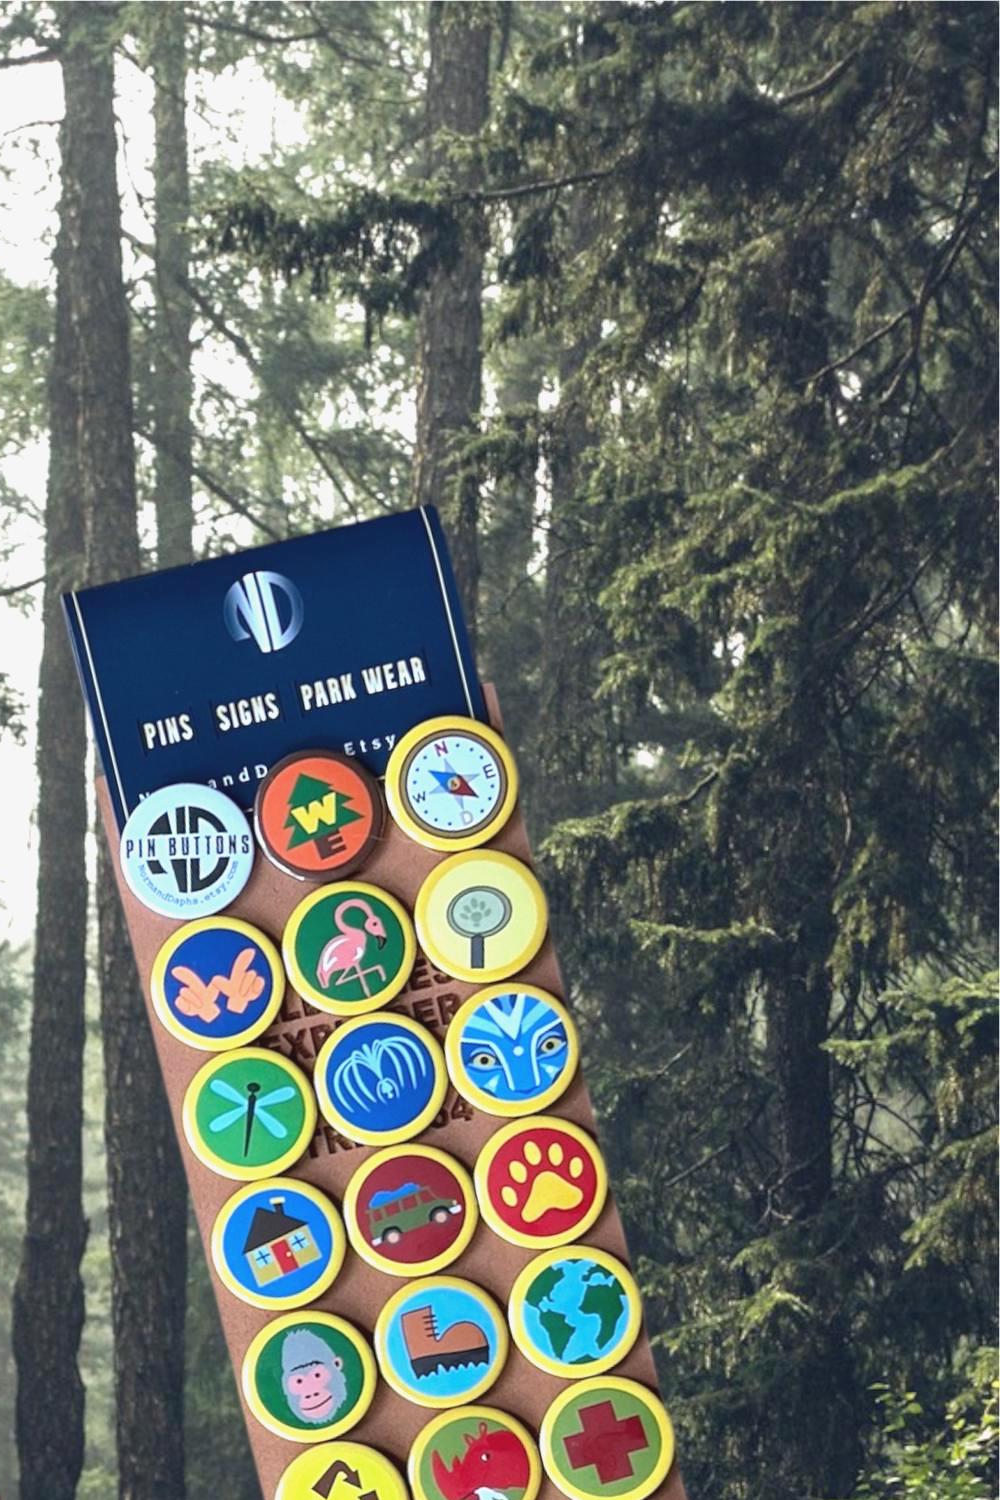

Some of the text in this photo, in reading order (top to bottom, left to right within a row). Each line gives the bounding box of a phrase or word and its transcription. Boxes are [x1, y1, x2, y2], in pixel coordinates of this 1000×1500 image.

[143, 656, 426, 749] PINS SIGNS PARK WEAR
[434, 740, 448, 757] N
[413, 764, 496, 803] W E
[291, 792, 336, 835] W
[460, 810, 474, 825] D
[126, 835, 250, 859] PIN BUTTONS
[314, 830, 348, 860] E
